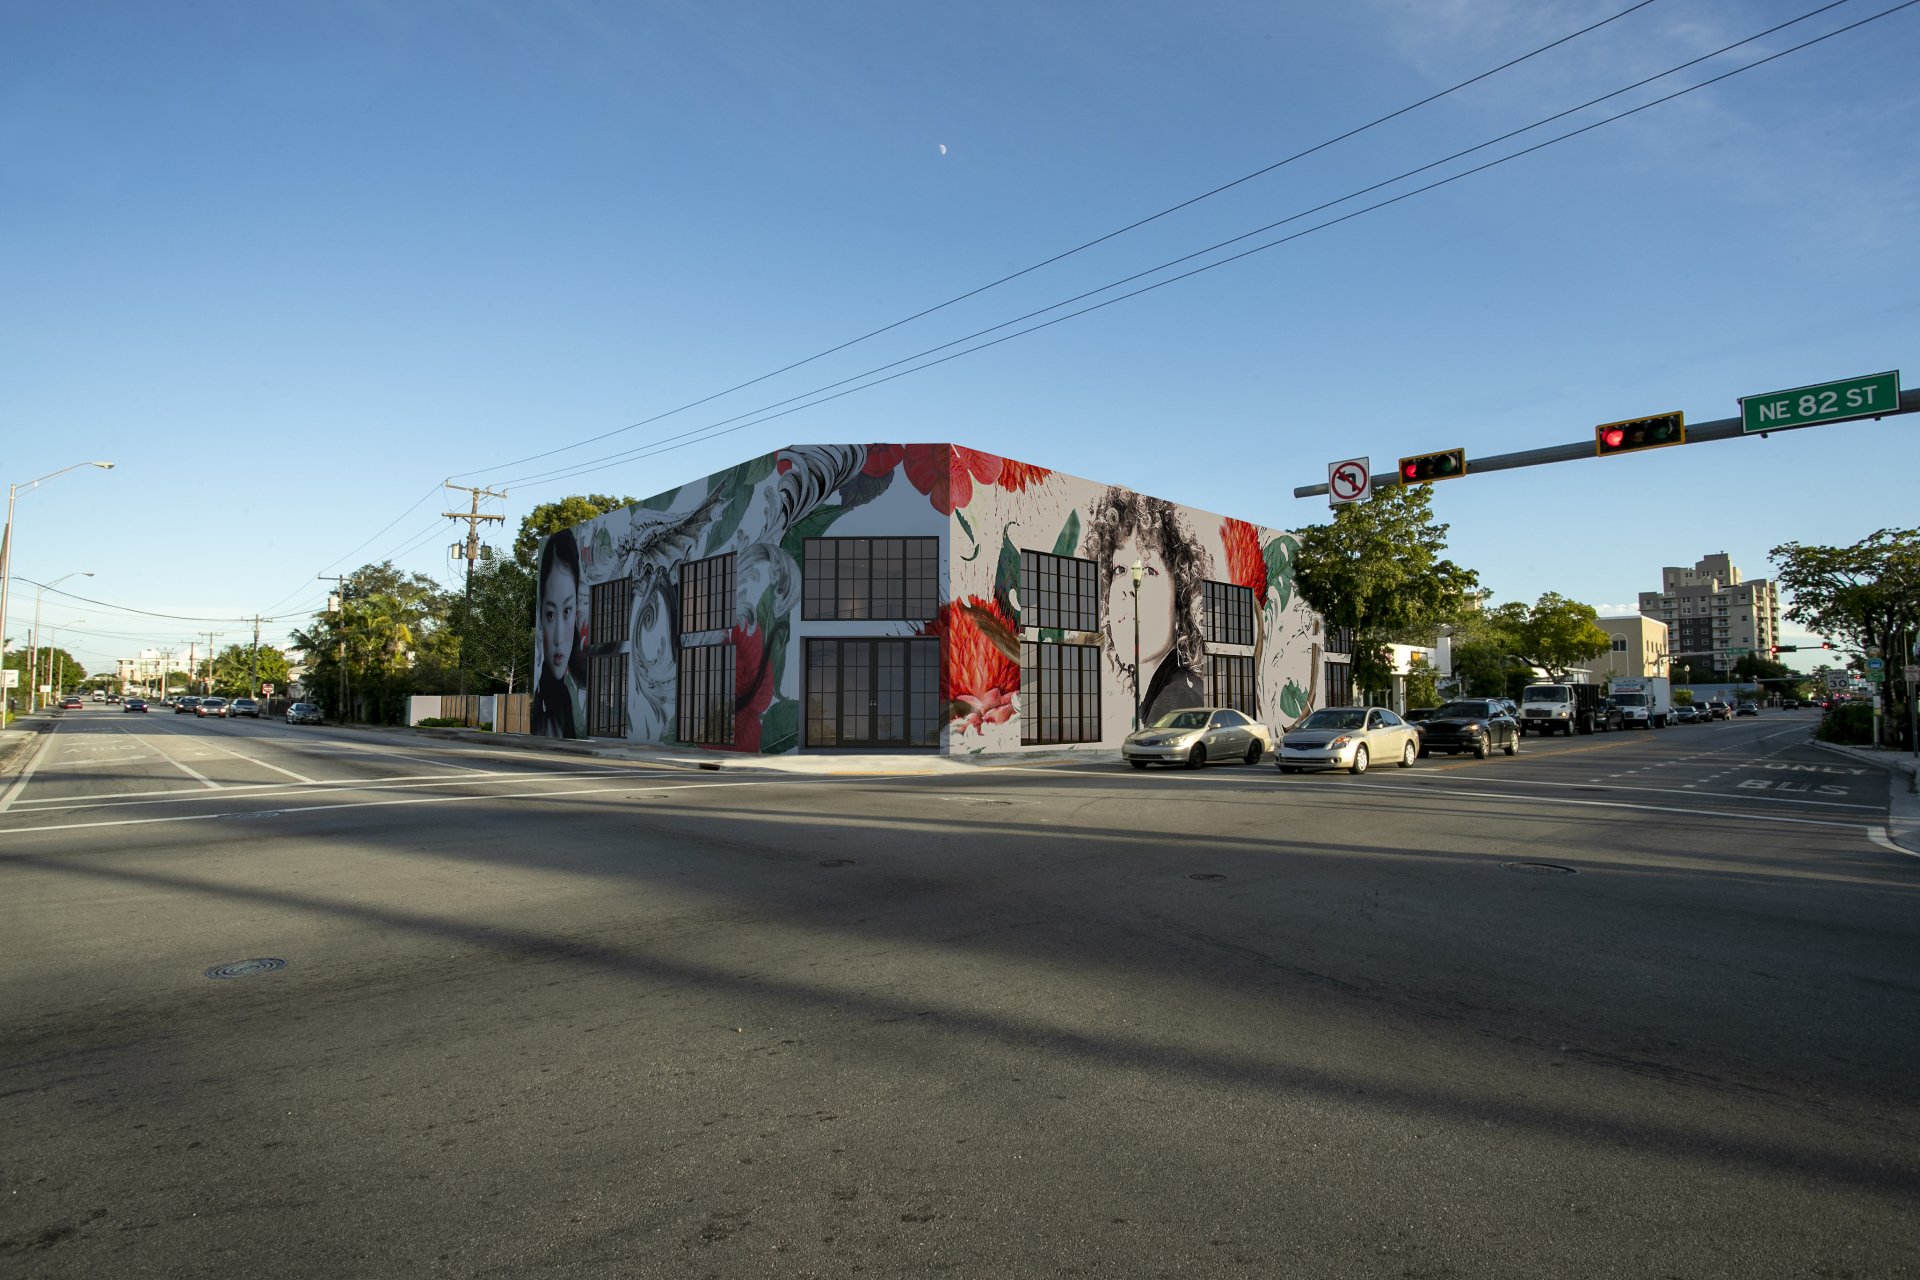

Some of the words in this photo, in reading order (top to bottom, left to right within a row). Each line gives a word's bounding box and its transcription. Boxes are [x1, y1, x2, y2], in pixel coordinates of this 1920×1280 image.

[1759, 400, 1791, 422] NE
[1798, 391, 1838, 417] 82
[1846, 385, 1877, 407] ST
[1829, 680, 1847, 688] 30
[1764, 763, 1868, 775] ONLY
[1736, 779, 1850, 795] BUS
